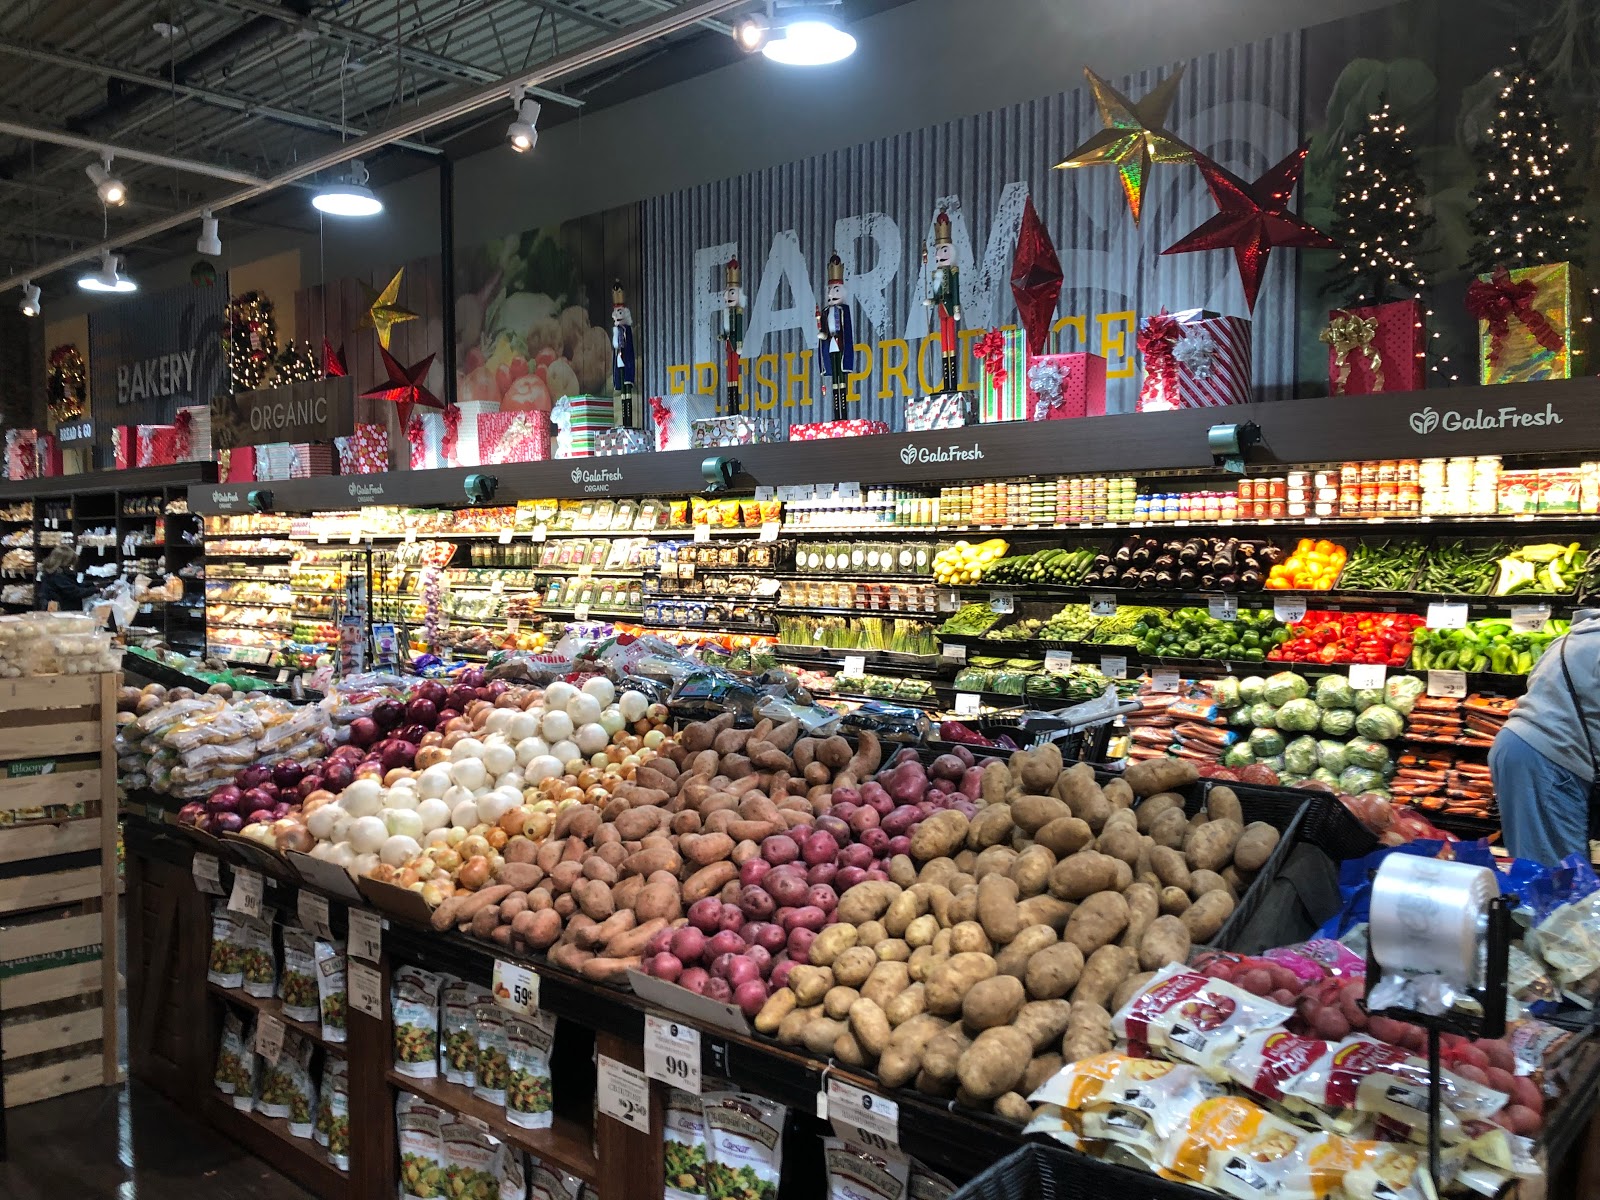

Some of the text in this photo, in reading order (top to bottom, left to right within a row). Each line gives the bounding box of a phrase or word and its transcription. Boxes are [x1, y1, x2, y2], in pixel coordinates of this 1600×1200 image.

[117, 348, 196, 404] BAKERY
[250, 397, 327, 432] ORGANIC
[1442, 403, 1564, 432] GalaFresh
[918, 443, 984, 463] GalaFresh
[582, 467, 623, 483] GalaFresh
[584, 484, 610, 492] ORGANIC
